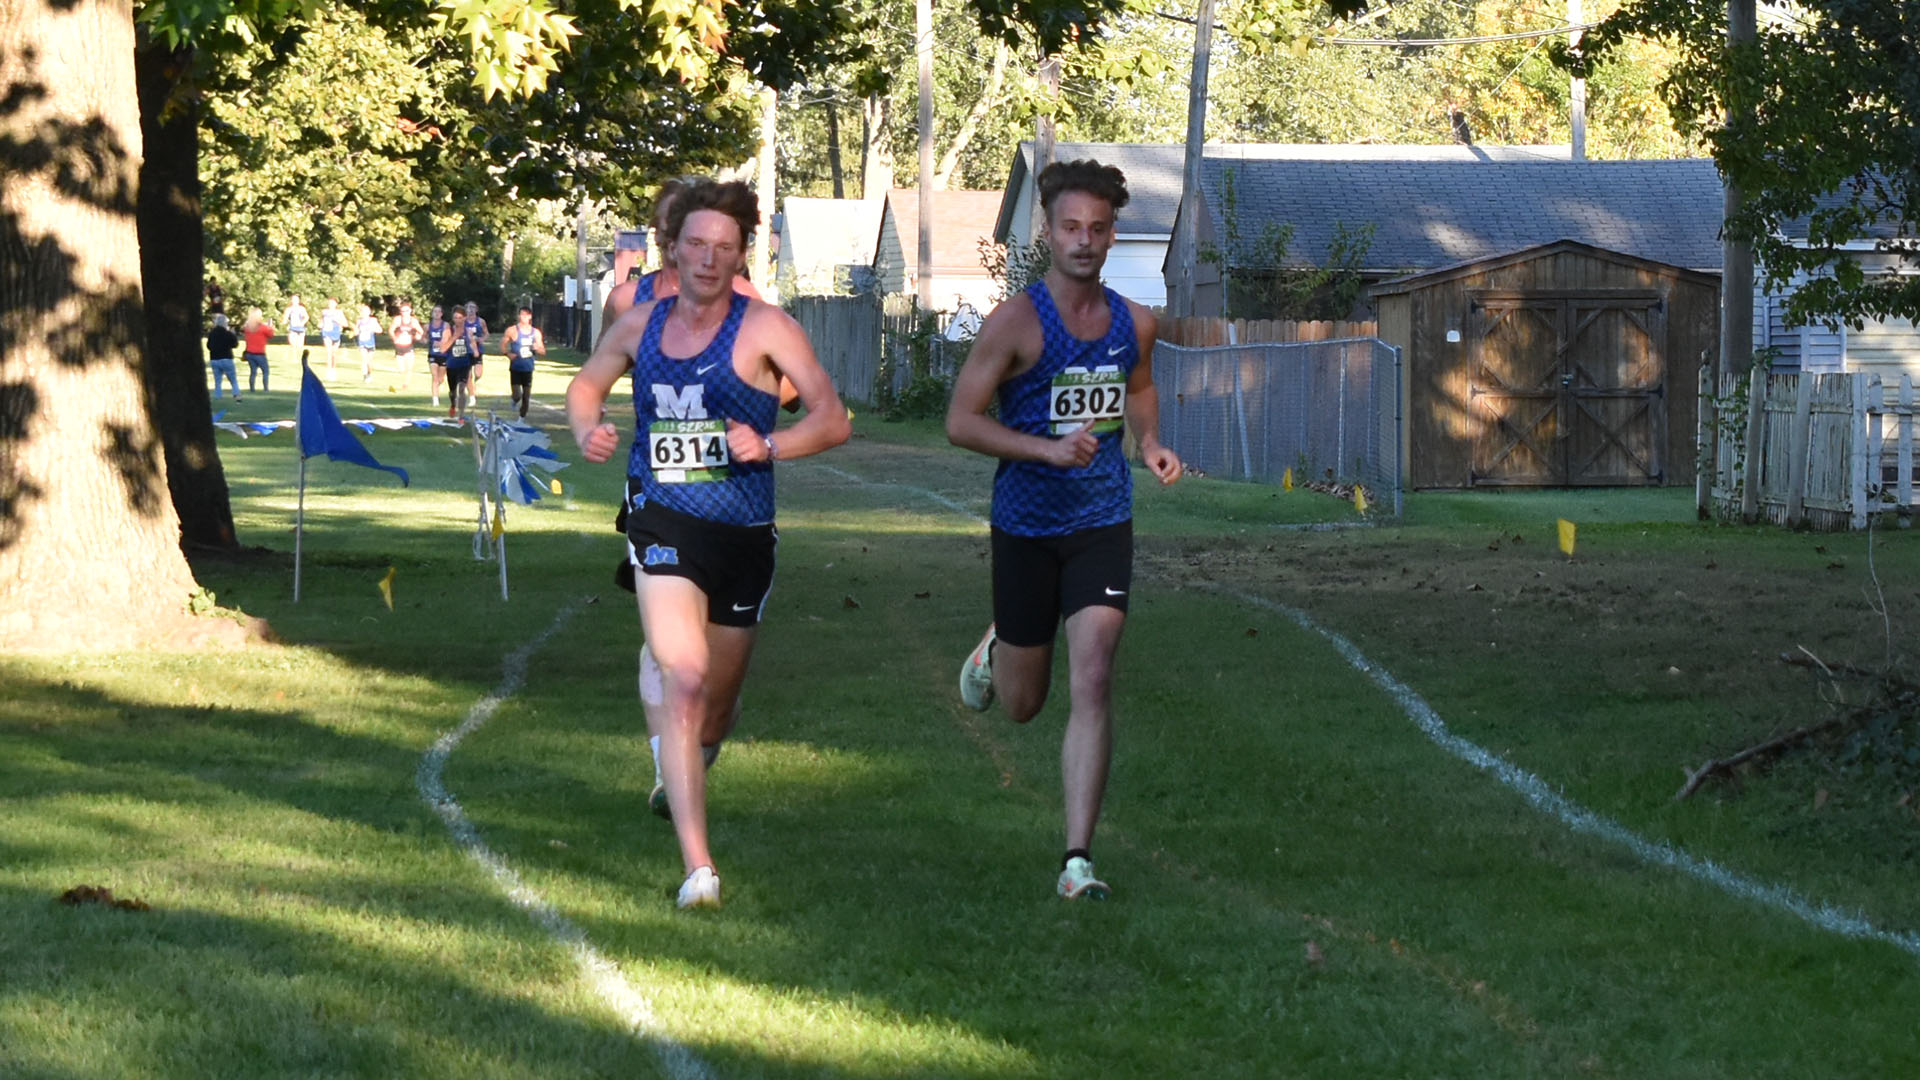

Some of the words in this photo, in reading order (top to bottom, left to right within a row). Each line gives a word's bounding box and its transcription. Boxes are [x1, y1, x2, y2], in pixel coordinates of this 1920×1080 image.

[652, 384, 708, 419] M
[1055, 387, 1121, 416] 6302
[655, 436, 724, 464] 6314
[644, 543, 679, 566] M
